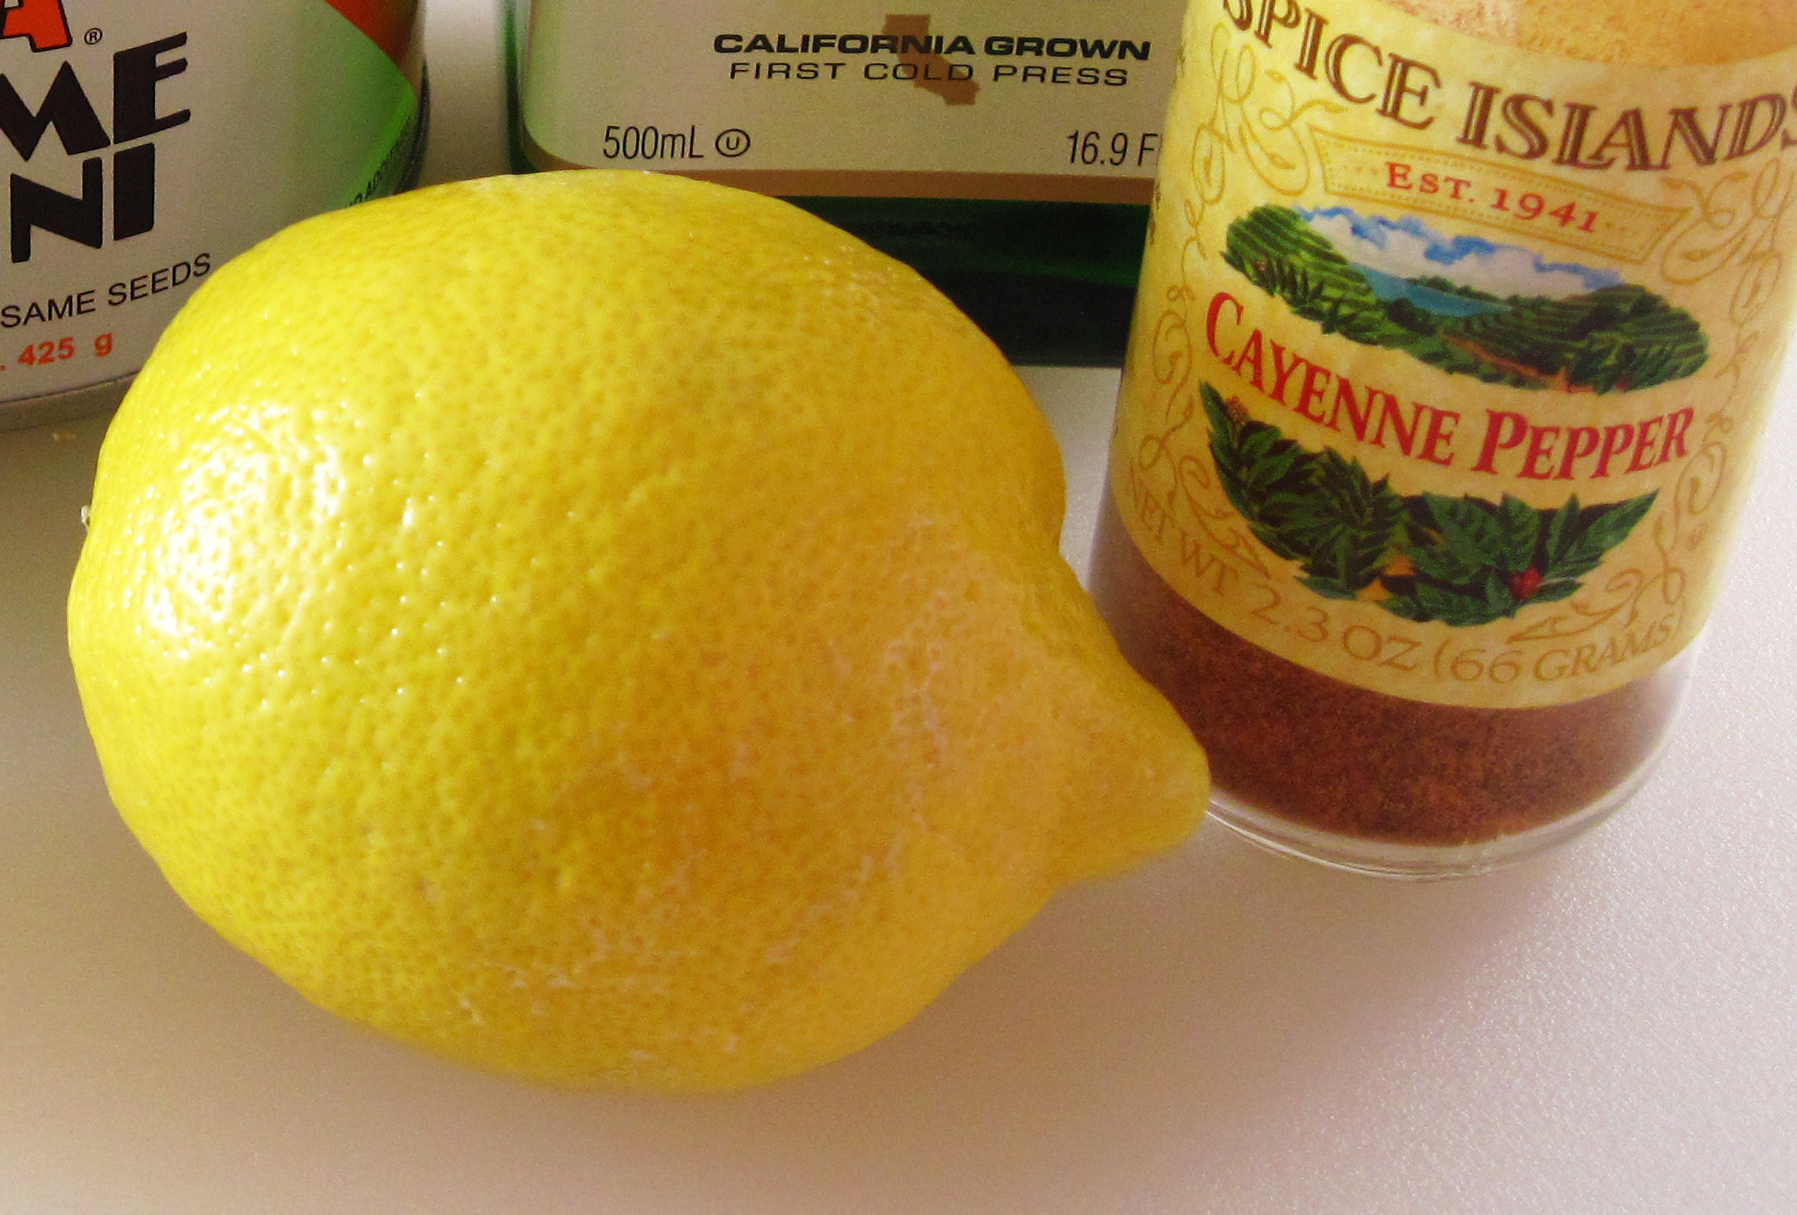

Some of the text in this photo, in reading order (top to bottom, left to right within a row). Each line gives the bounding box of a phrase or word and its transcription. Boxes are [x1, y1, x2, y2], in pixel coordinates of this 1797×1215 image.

[712, 33, 1152, 62] CALIFORNIA GROWN
[728, 61, 1129, 87] FIRST COLD PRESS
[602, 124, 706, 161] 500mL
[1066, 129, 1129, 166] 16.9
[1385, 160, 1602, 234] EST. 1941
[107, 252, 213, 306] SEEDS
[17, 336, 76, 368] 425
[93, 332, 115, 359] g
[1204, 290, 1696, 482] CAYENNE PEPPER
[1179, 526, 1240, 597] WT
[1250, 583, 1330, 644] 2.3
[1342, 623, 1423, 673] OZ
[1433, 636, 1525, 685] (66
